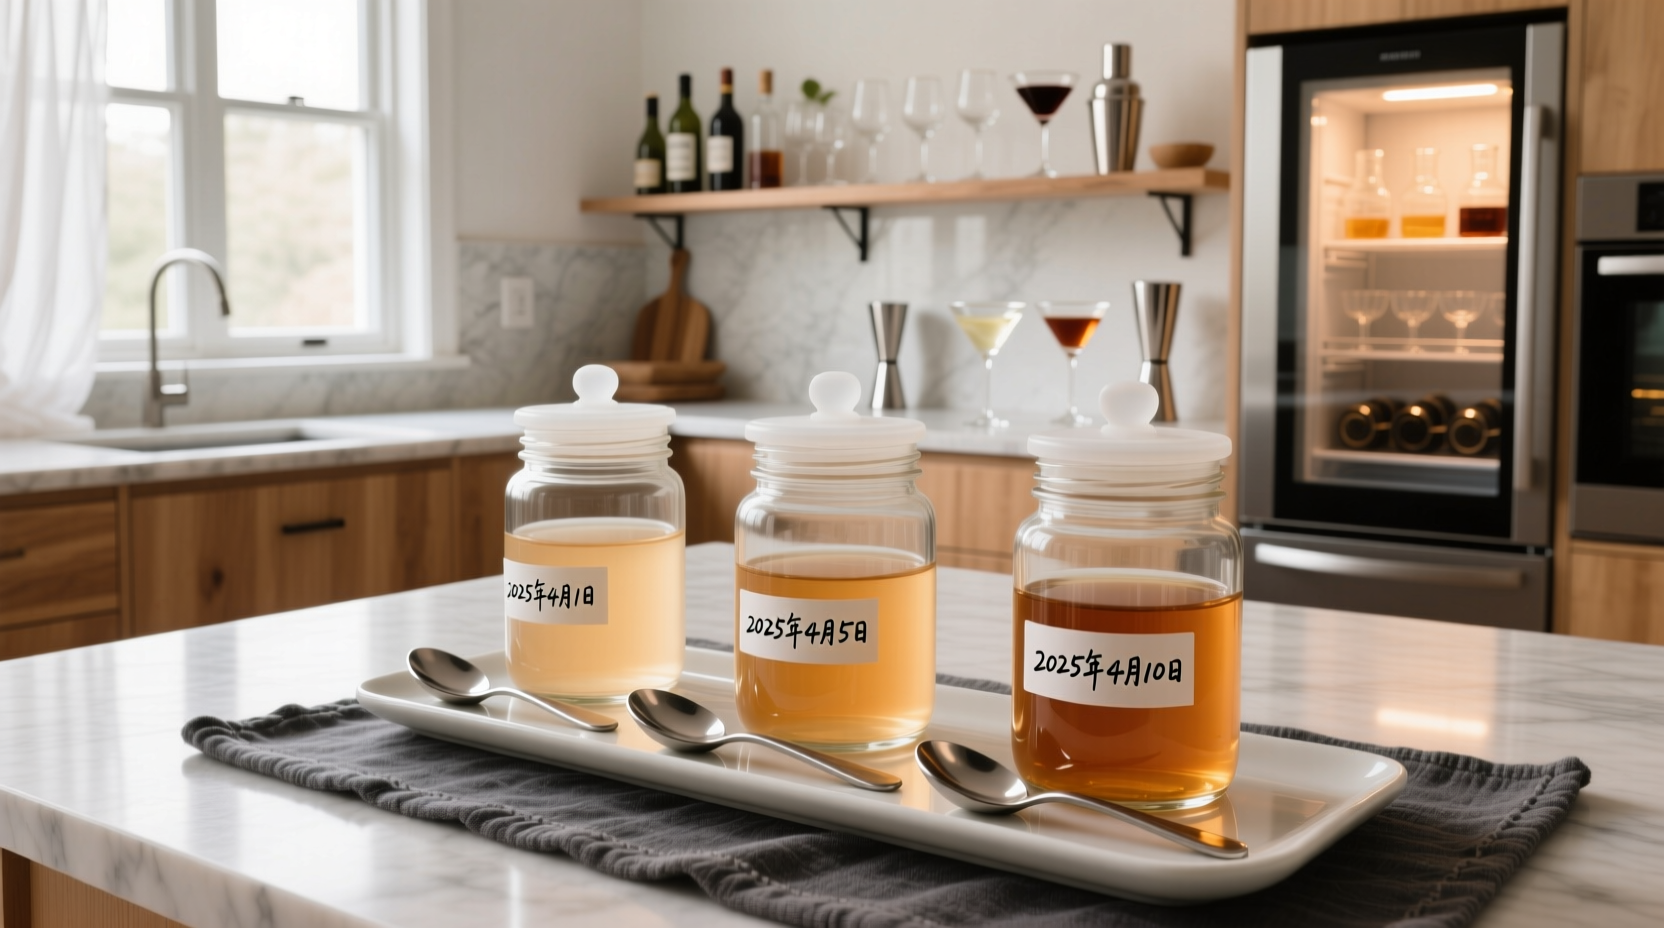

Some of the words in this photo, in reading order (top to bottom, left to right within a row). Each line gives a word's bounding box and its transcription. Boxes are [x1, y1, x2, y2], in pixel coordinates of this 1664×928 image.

[746, 612, 867, 650] 2025年4月5日
[1033, 649, 1182, 692] 2025年4月10日
